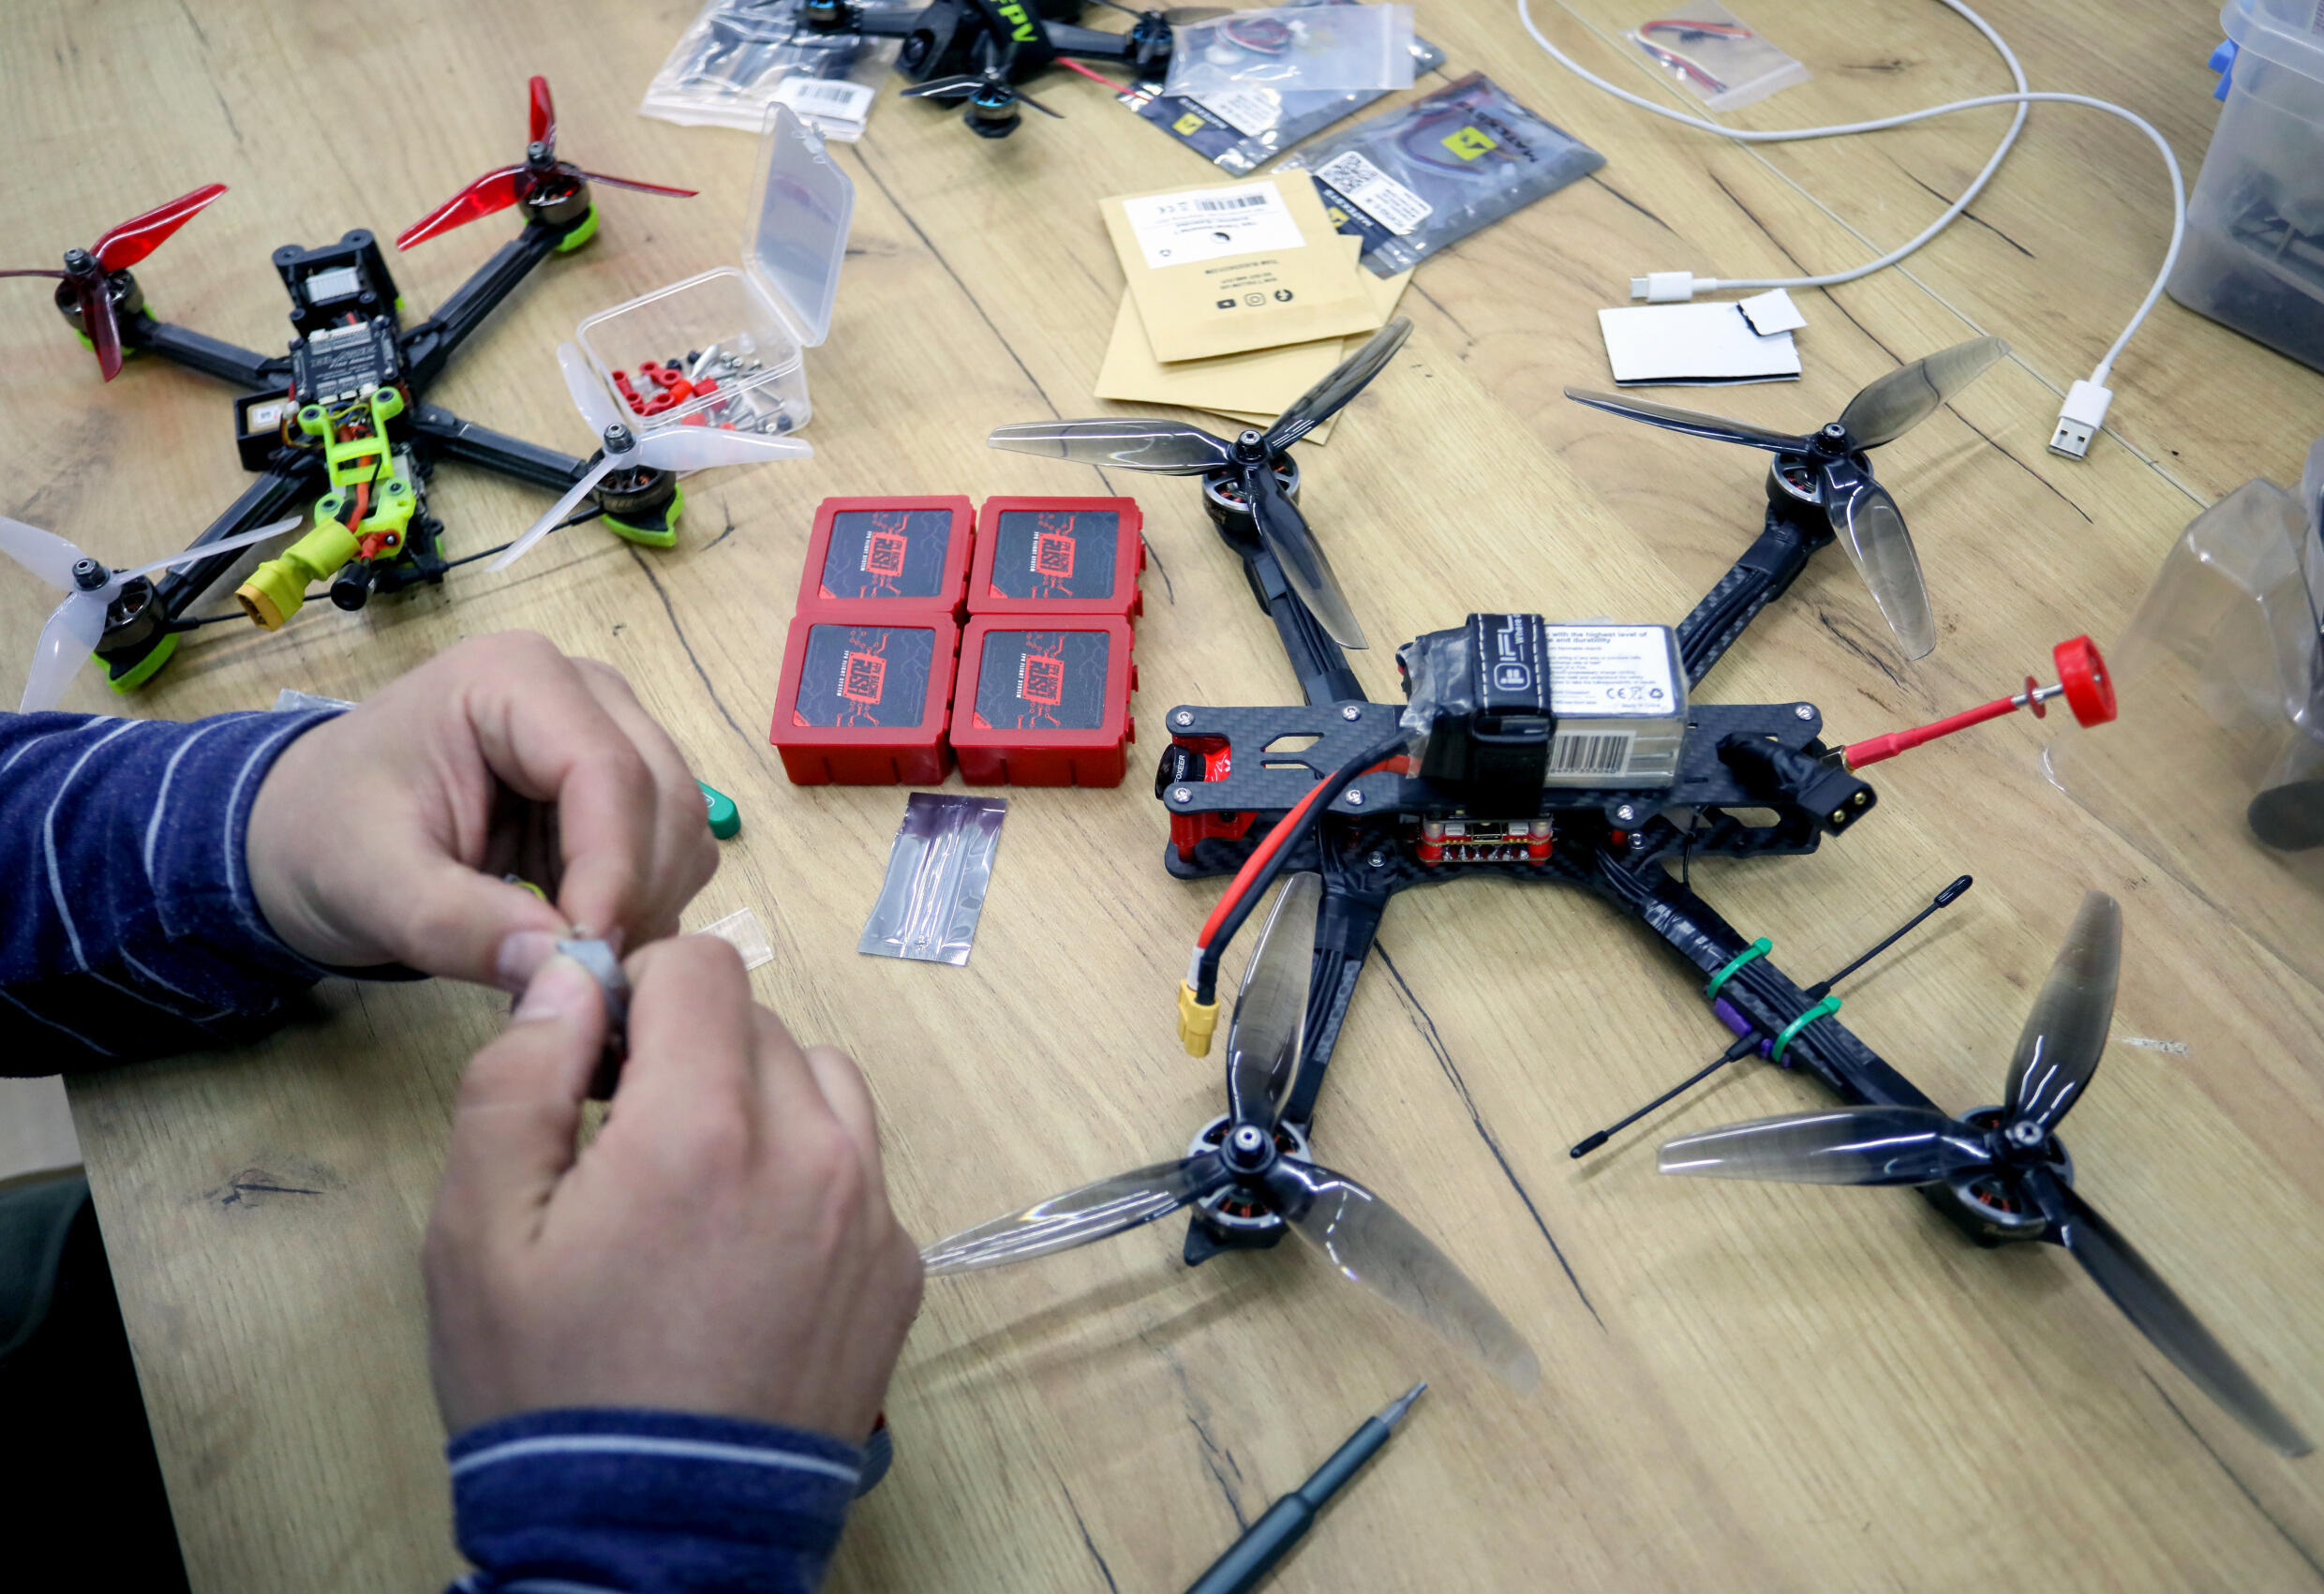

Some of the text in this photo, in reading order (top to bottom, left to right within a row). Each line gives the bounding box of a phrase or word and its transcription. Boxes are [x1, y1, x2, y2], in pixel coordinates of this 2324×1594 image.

[990, 0, 1038, 41] PV
[872, 538, 893, 571] RUSH
[1040, 539, 1061, 572] RUSH
[848, 659, 872, 696] RUSH
[1027, 661, 1050, 697] RUSH
